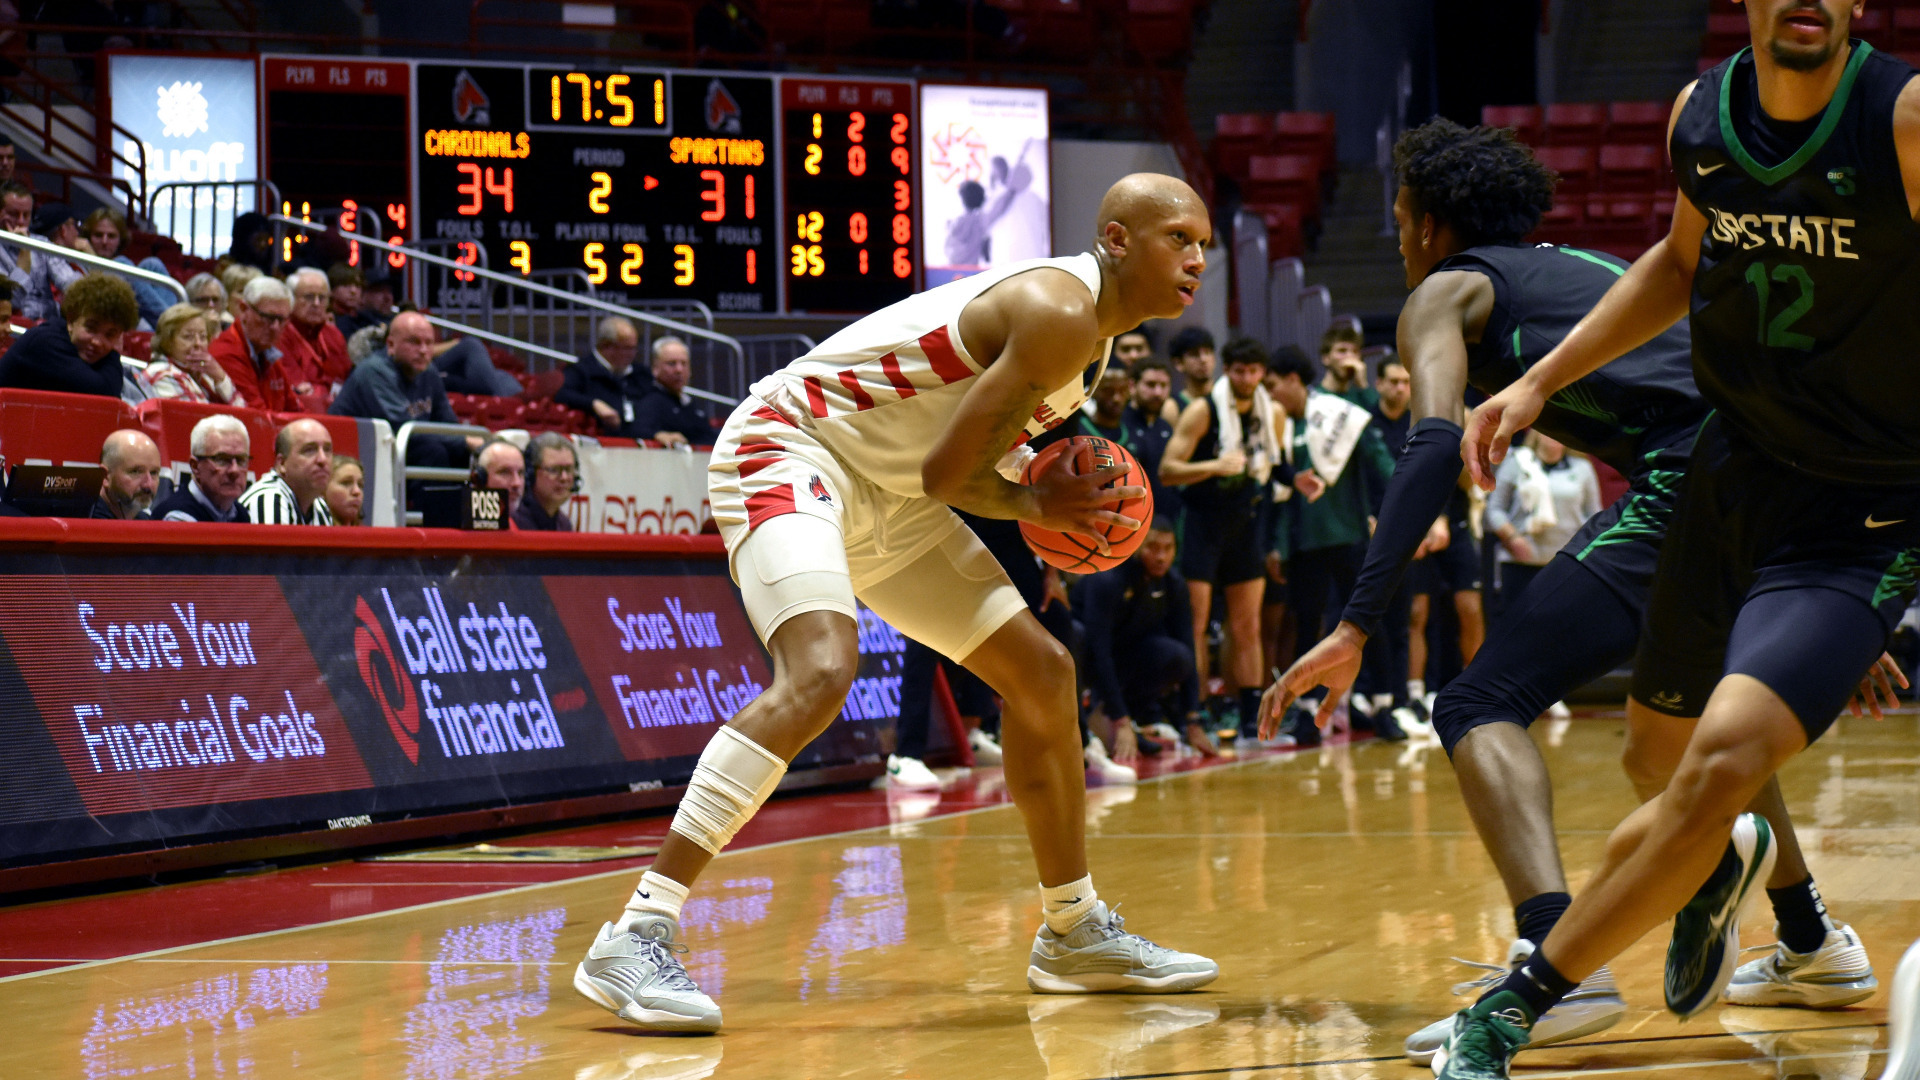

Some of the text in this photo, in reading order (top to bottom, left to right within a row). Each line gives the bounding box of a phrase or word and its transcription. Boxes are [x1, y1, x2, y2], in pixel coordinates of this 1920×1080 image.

[328, 66, 350, 86] FLS
[364, 68, 387, 87] PTS
[551, 73, 664, 127] 17:51
[425, 129, 530, 158] CARDINALS
[847, 111, 866, 143] 2
[890, 113, 908, 144] 2
[573, 148, 625, 167] PERIOD
[669, 137, 764, 166] SPARTANS
[804, 143, 909, 176] 2 0 9
[457, 163, 514, 215] 34
[588, 171, 612, 213] 2
[700, 170, 755, 221] 31
[893, 179, 910, 211] 3
[387, 203, 406, 230] 4
[436, 219, 484, 239] FOULS
[555, 222, 649, 242] PLAYER FOUL
[797, 211, 911, 244] 12 0 8
[1708, 207, 1859, 260] UPSTATE
[716, 226, 762, 245] FOULS
[674, 244, 695, 286] 3
[746, 248, 757, 284] 1
[791, 244, 825, 276] 35
[893, 247, 911, 278] 6
[1745, 262, 1816, 350] 12
[471, 490, 501, 519] POSS
[78, 600, 257, 673] Score Your
[381, 587, 547, 675] ball state
[607, 596, 723, 653] Score Your
[611, 667, 716, 729] Financial
[73, 689, 326, 773] Financial Goals
[421, 673, 565, 758] financial
[327, 814, 373, 830] DAKTRONICS
